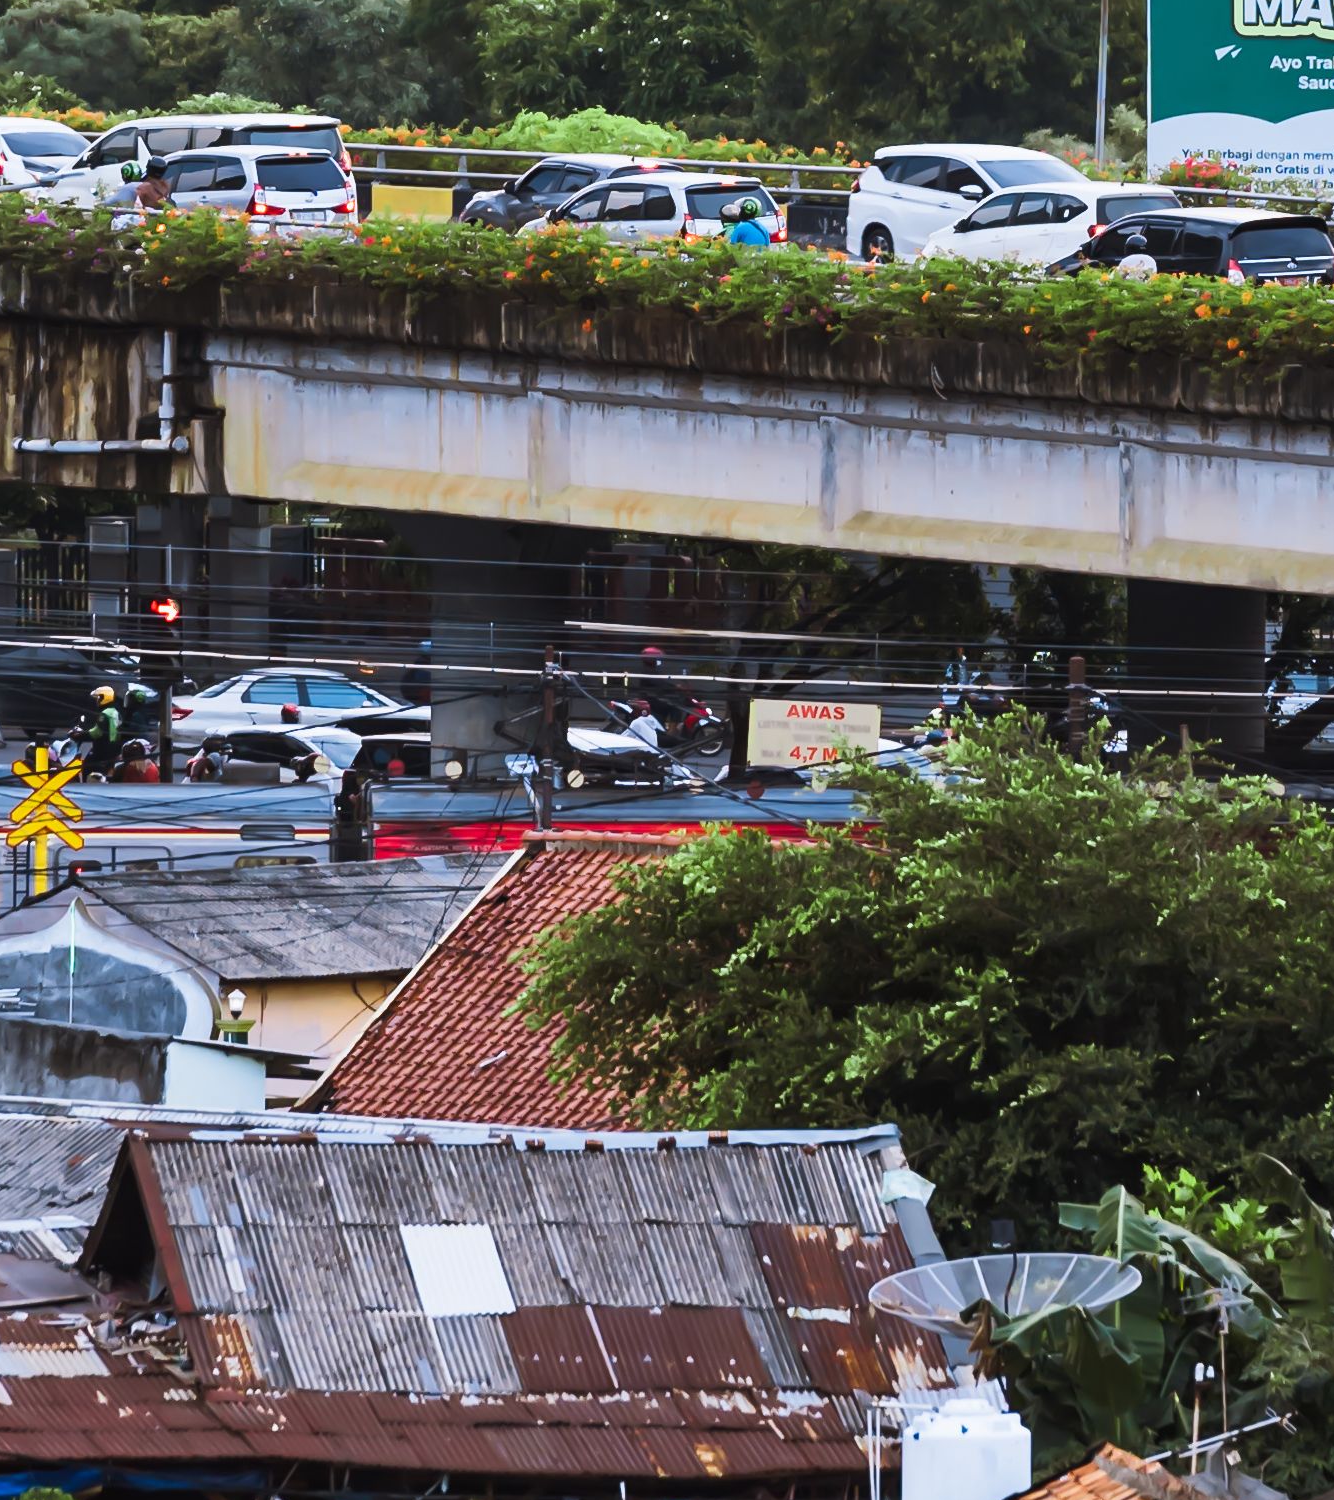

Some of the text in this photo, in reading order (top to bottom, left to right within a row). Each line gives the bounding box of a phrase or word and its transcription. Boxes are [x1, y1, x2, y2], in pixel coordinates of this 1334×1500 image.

[1270, 55, 1303, 72] Ayo
[1256, 148, 1300, 162] dengan
[1275, 163, 1309, 175] Gratis
[1313, 164, 1324, 175] di
[786, 704, 845, 720] AWAS
[789, 745, 818, 763] 4,7
